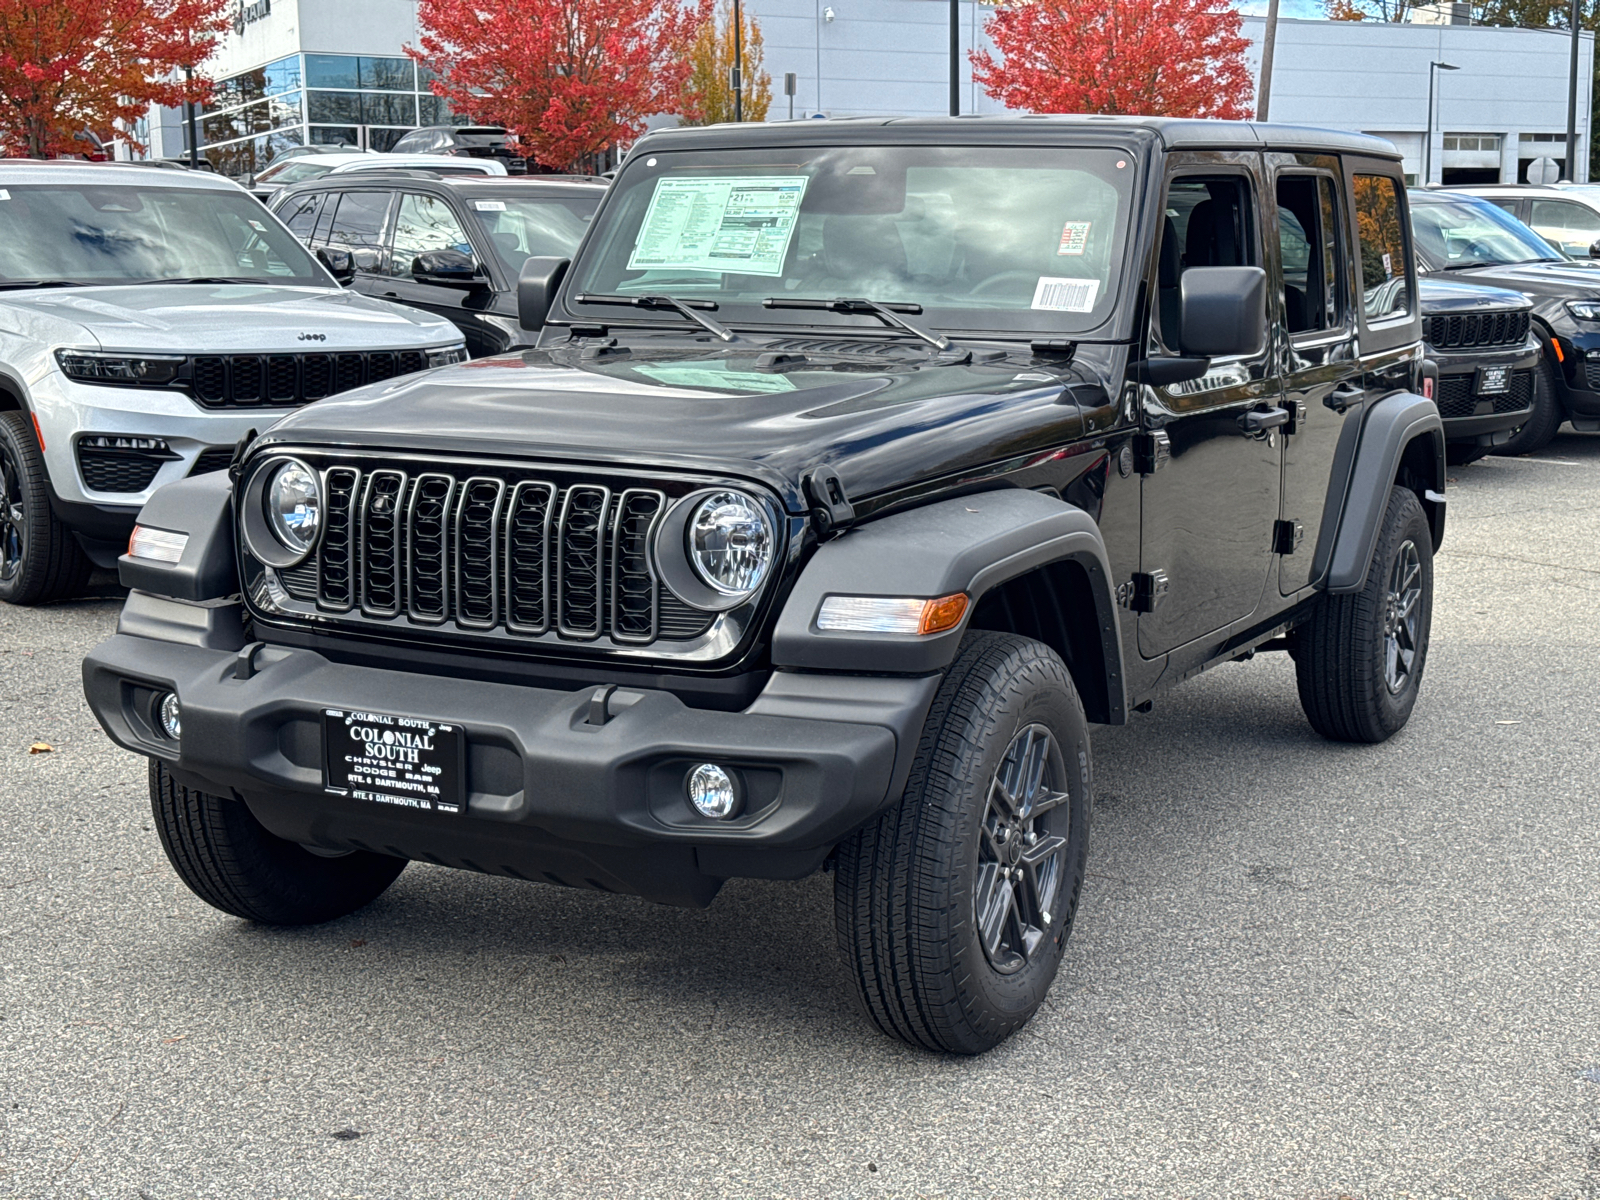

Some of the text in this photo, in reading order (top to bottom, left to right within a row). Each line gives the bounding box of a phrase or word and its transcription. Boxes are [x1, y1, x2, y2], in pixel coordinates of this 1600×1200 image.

[241, 0, 270, 22] RAM
[733, 193, 744, 202] 21
[297, 331, 327, 343] Jeep
[350, 711, 394, 725] COLONIAL
[398, 718, 430, 730] SOUTH
[349, 725, 434, 751] COLONIAL
[364, 742, 420, 763] SOUTH
[344, 755, 442, 776] CHRYSLER Jeep
[353, 765, 433, 783] DODGE RAM
[347, 773, 441, 795] RTE. 6 DARTMOUTH, MA
[352, 790, 432, 810] RTE. 6 DARTMOUTH, MA
